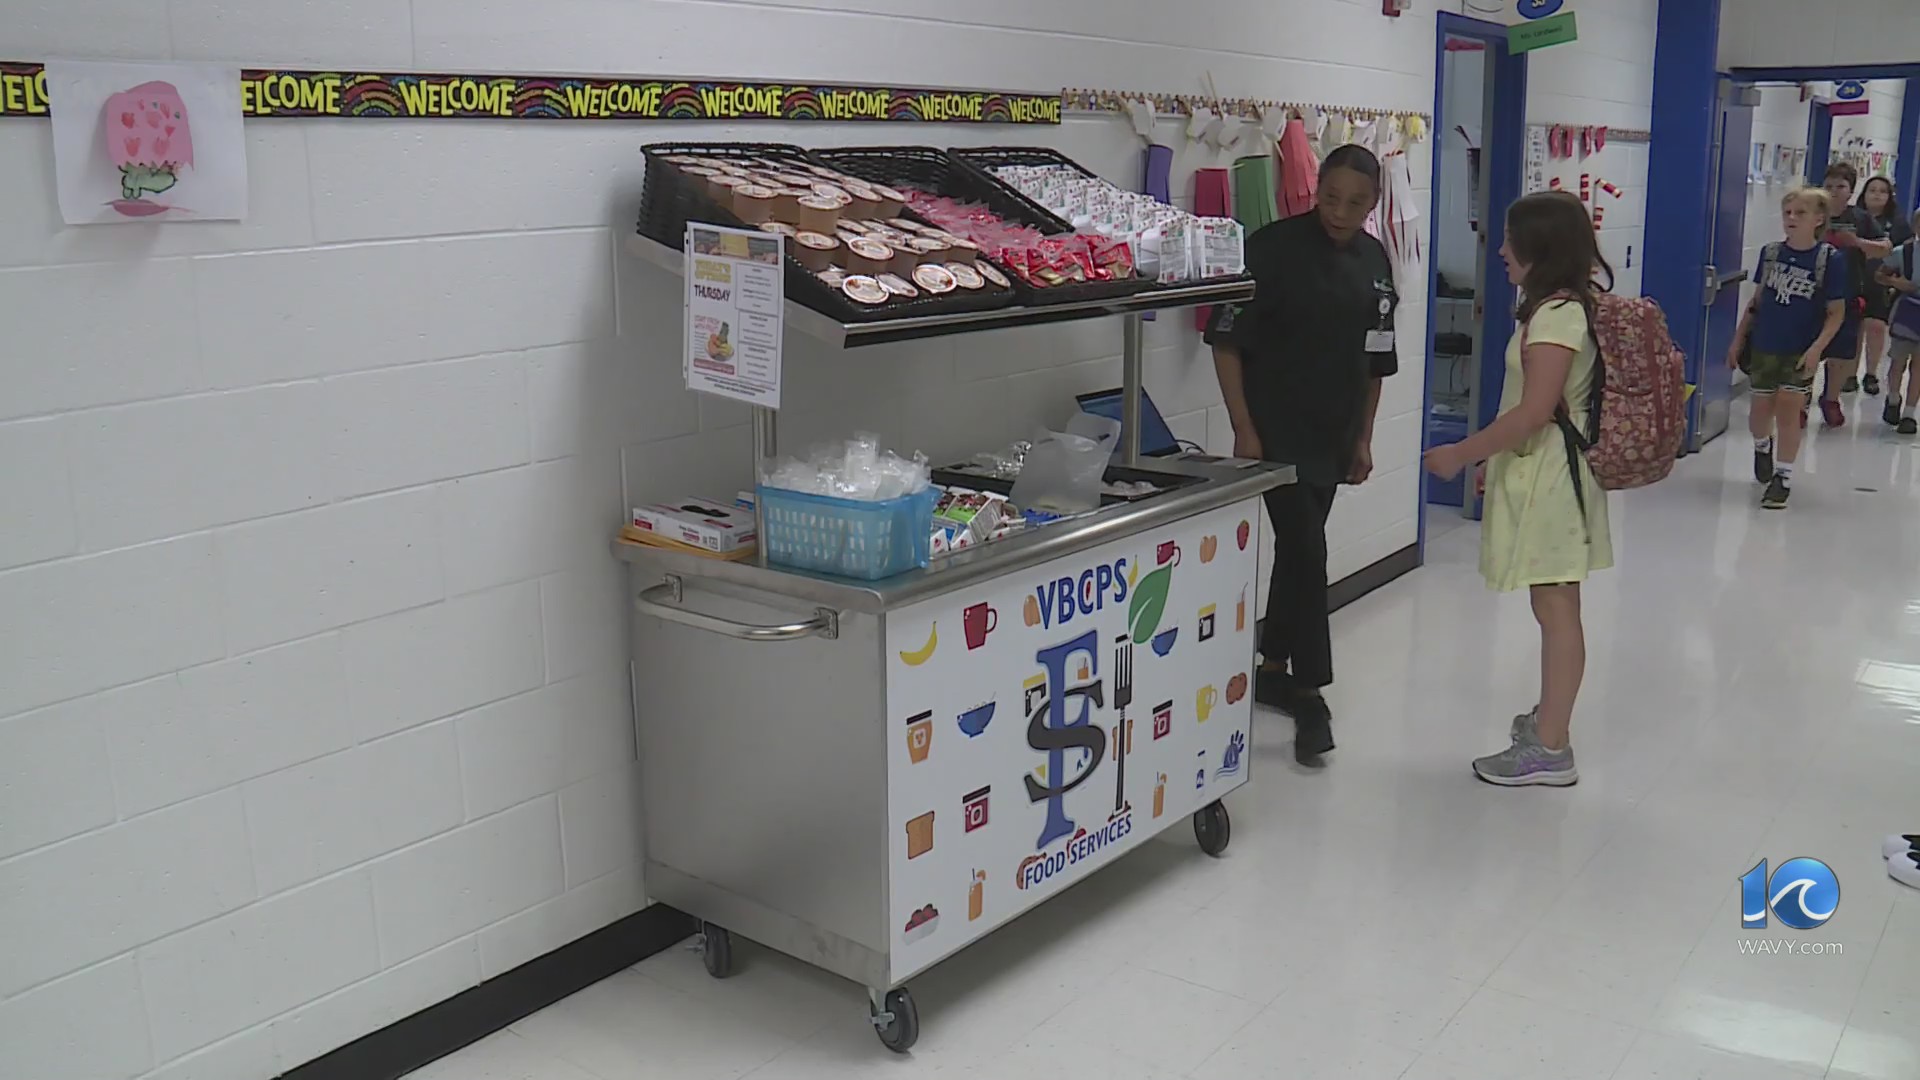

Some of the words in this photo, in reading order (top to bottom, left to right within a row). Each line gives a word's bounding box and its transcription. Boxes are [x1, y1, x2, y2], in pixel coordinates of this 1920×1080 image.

[241, 75, 341, 114] ELCOME
[398, 79, 515, 116] WELCOME
[566, 83, 662, 117] WELCOME
[701, 86, 783, 118] WELCOME
[819, 91, 889, 119] WELCOME
[920, 94, 982, 121] WELCOME
[1008, 97, 1061, 122] WELCOME
[694, 285, 731, 302] THURSDAY
[1036, 558, 1127, 630] VBCPS
[1025, 851, 1065, 889] FOOD
[1070, 813, 1132, 865] SERVICES
